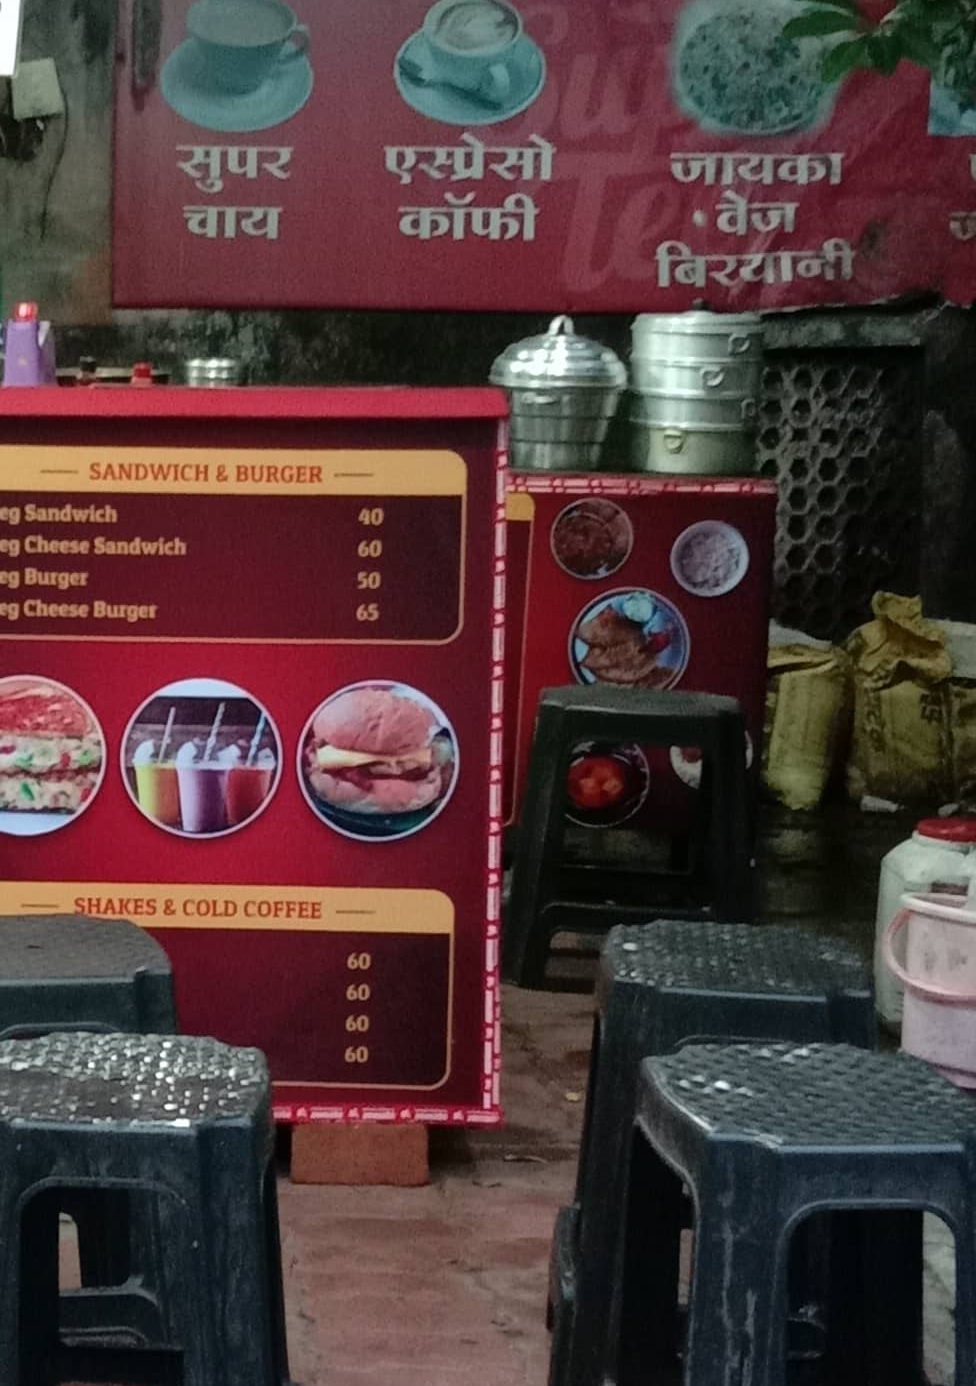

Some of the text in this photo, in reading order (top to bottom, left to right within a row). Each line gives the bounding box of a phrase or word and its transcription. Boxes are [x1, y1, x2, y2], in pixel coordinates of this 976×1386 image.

[176, 144, 293, 193] सुपर
[384, 133, 556, 185] एस्प्रेसो
[670, 151, 845, 186] जायका
[183, 205, 283, 240] चाय
[398, 192, 540, 241] कॉफी
[715, 189, 800, 236] वेज
[655, 238, 856, 288] बिरयानी
[89, 462, 323, 484] SANDWICH & BURGER
[24, 503, 117, 524] Sandwich
[358, 508, 384, 526] 40
[24, 536, 90, 556] Cheese
[94, 536, 186, 557] Sandwich
[357, 540, 382, 558] 60
[24, 568, 88, 590] Burger
[357, 572, 381, 590] 50
[23, 599, 88, 619] Cheese
[93, 600, 157, 622] Burger
[356, 603, 379, 622] 65
[74, 896, 322, 919] SHAKES & COLD COFFEE
[346, 952, 371, 971] 60
[345, 984, 370, 1002] 60
[345, 1015, 369, 1033] 60
[344, 1046, 368, 1064] 60
